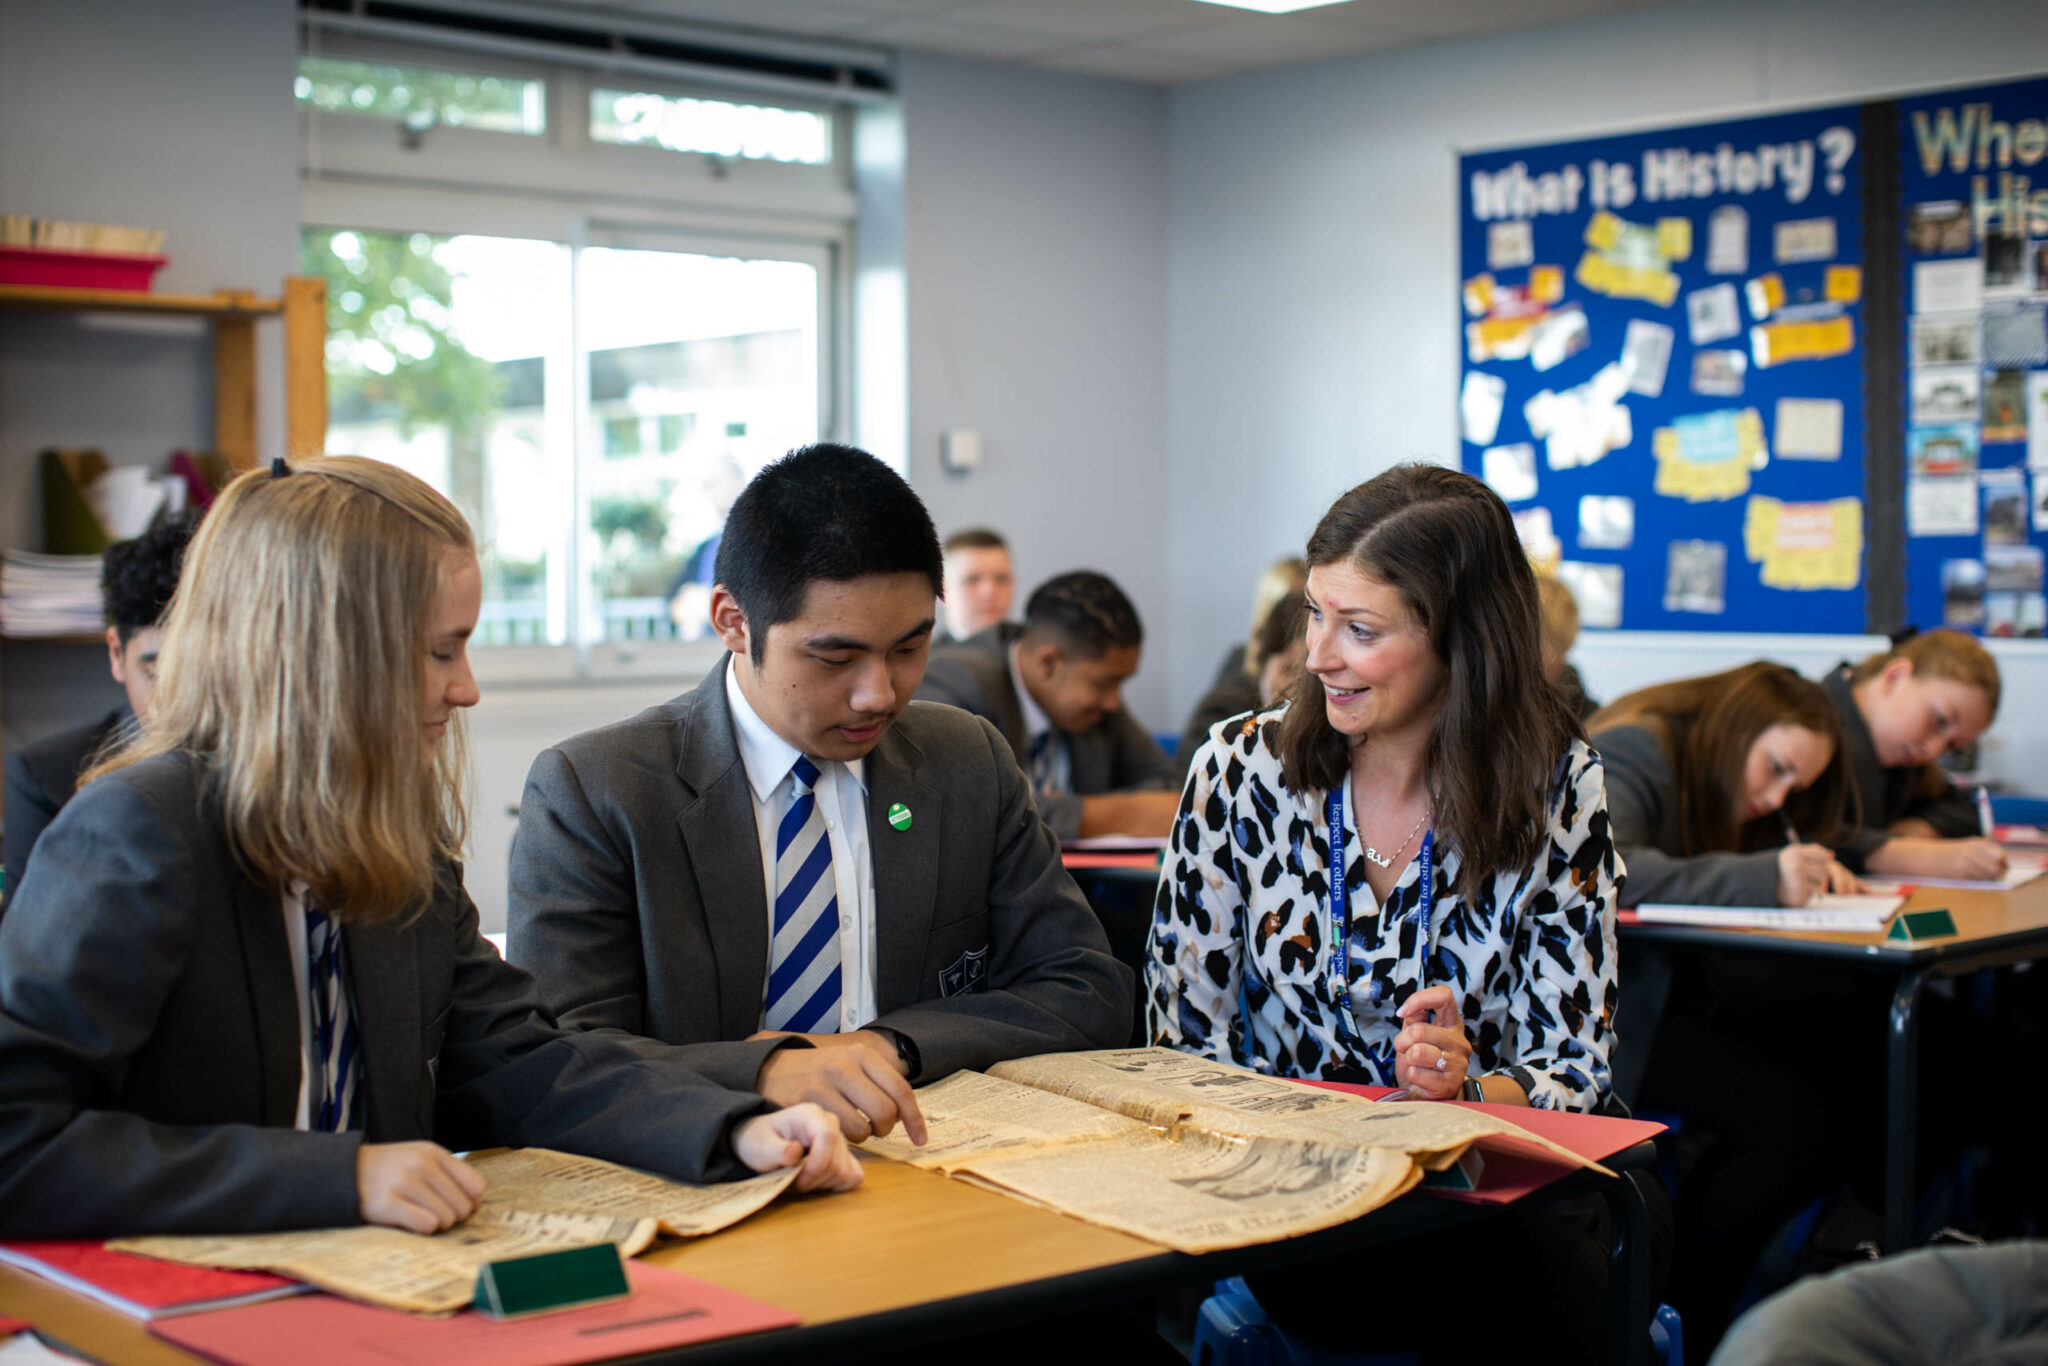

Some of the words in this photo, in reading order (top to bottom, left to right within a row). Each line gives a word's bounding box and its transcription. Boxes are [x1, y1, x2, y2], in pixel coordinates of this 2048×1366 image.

[1911, 103, 2048, 176] Whe
[1471, 161, 1583, 221] What
[1331, 803, 1343, 845] Respect
[1333, 847, 1344, 864] for
[1420, 845, 1430, 881] others
[1333, 866, 1345, 902] others
[1420, 882, 1429, 899] for
